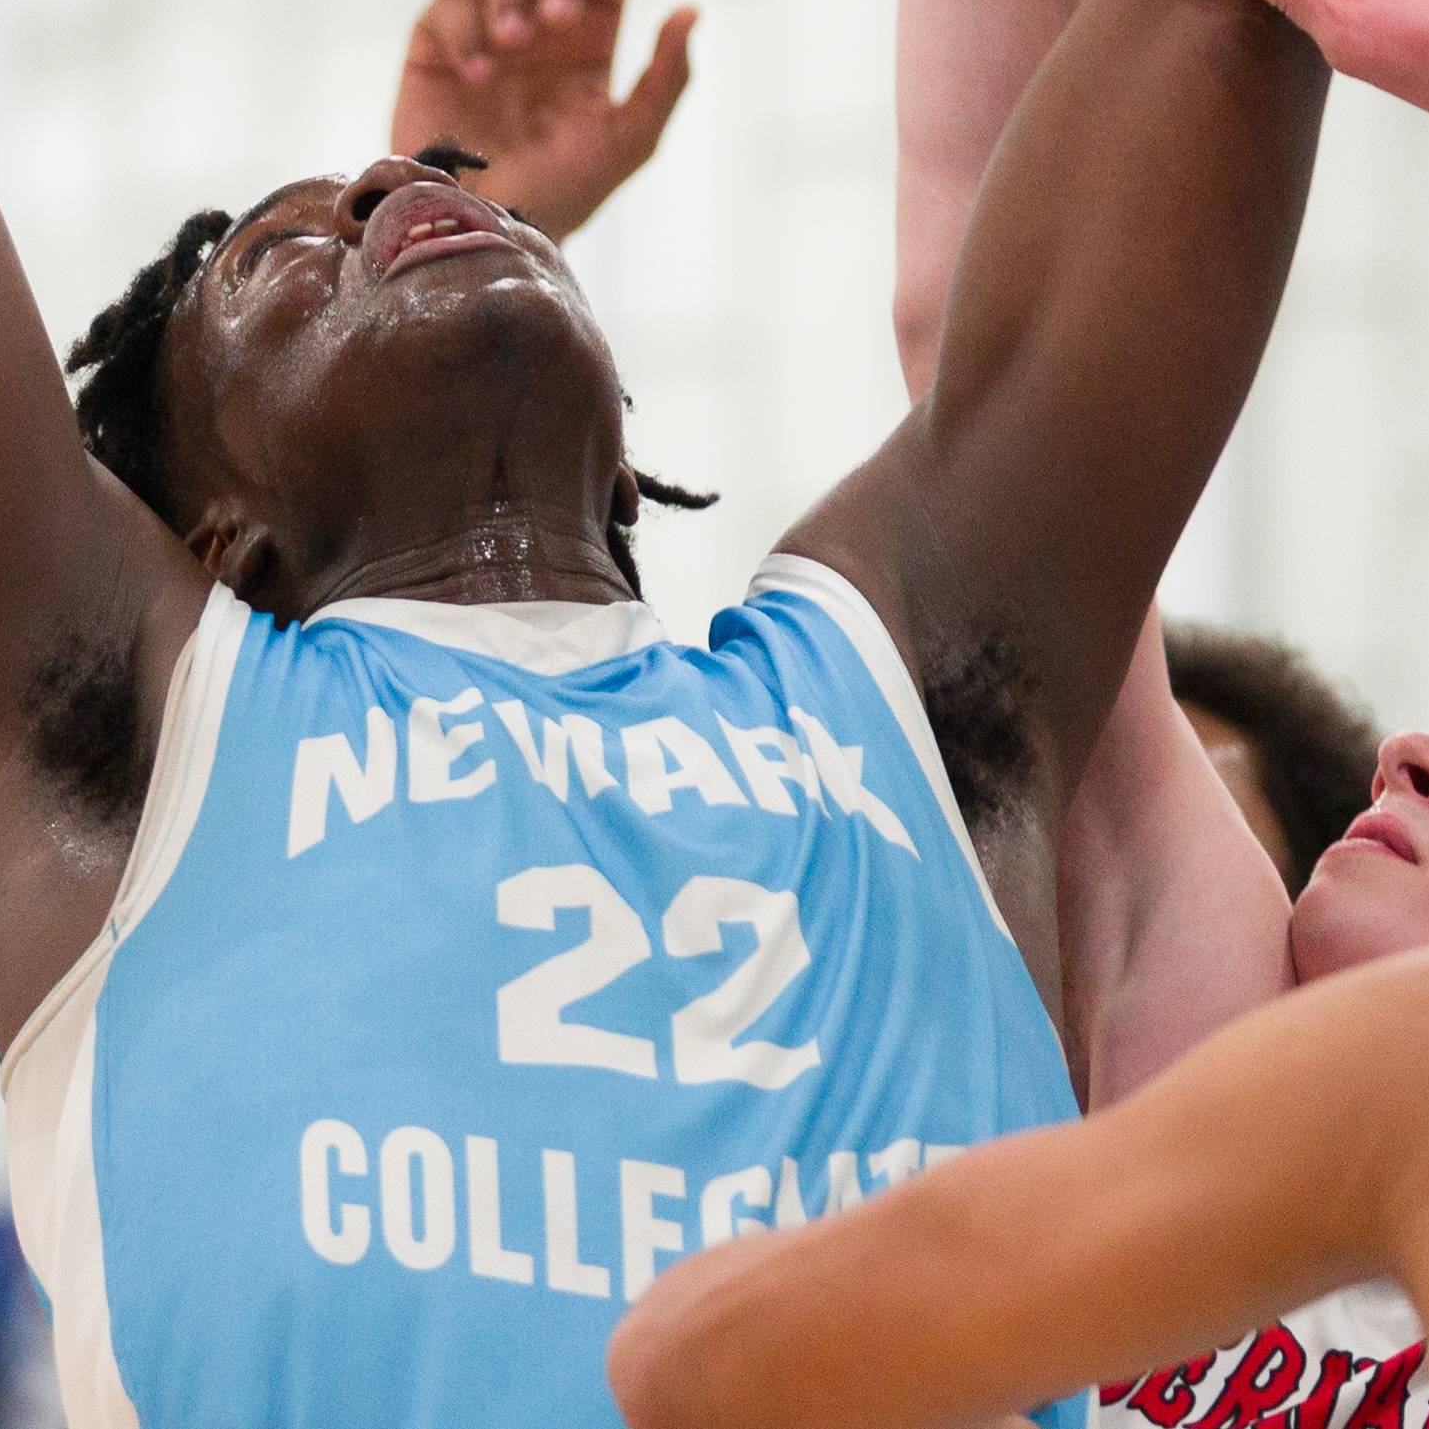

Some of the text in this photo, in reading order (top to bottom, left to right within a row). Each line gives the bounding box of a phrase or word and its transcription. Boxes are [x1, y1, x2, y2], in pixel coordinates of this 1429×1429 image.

[287, 685, 922, 862] NEWARK
[496, 862, 822, 1090] 22
[299, 1117, 972, 1302] COLLEGI
